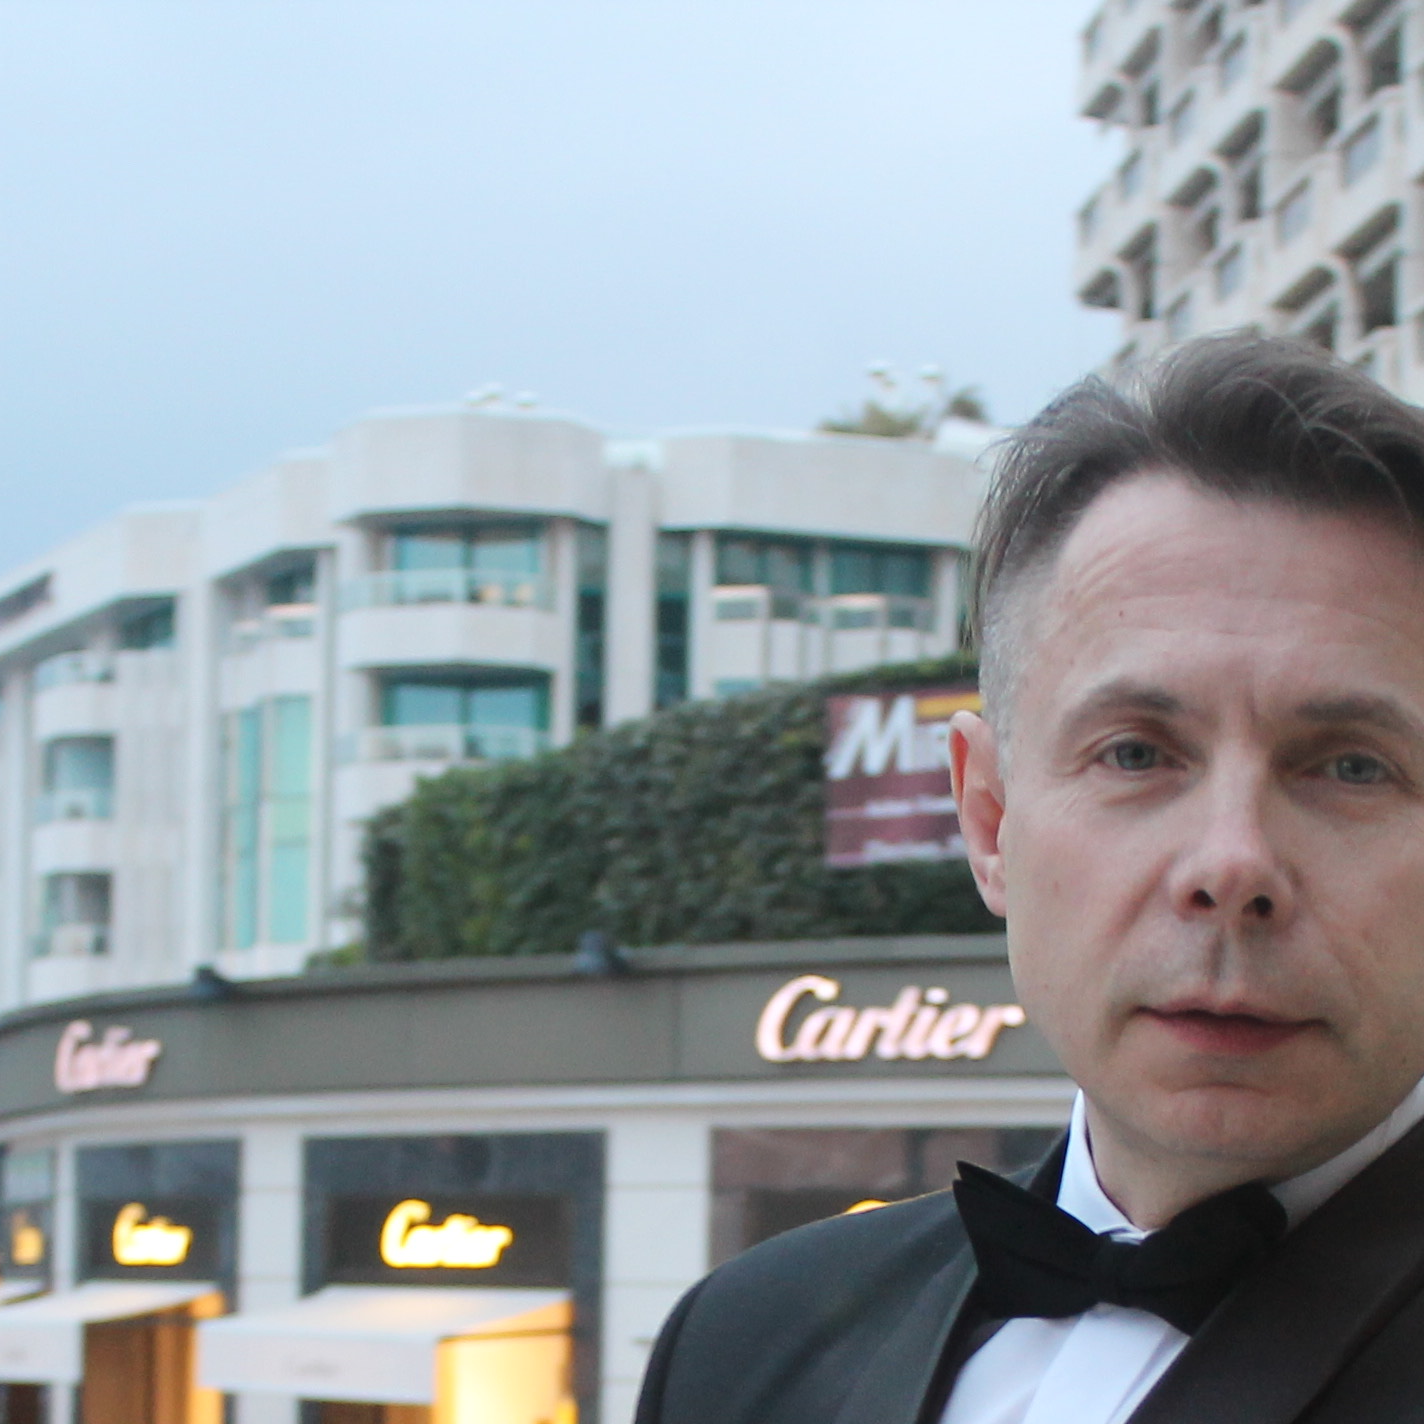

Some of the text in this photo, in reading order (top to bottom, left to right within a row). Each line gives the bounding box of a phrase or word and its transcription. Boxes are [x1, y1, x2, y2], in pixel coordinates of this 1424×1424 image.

[53, 1018, 163, 1094] Cartier
[755, 974, 1026, 1062] Cartier
[379, 1199, 514, 1269] Cartier
